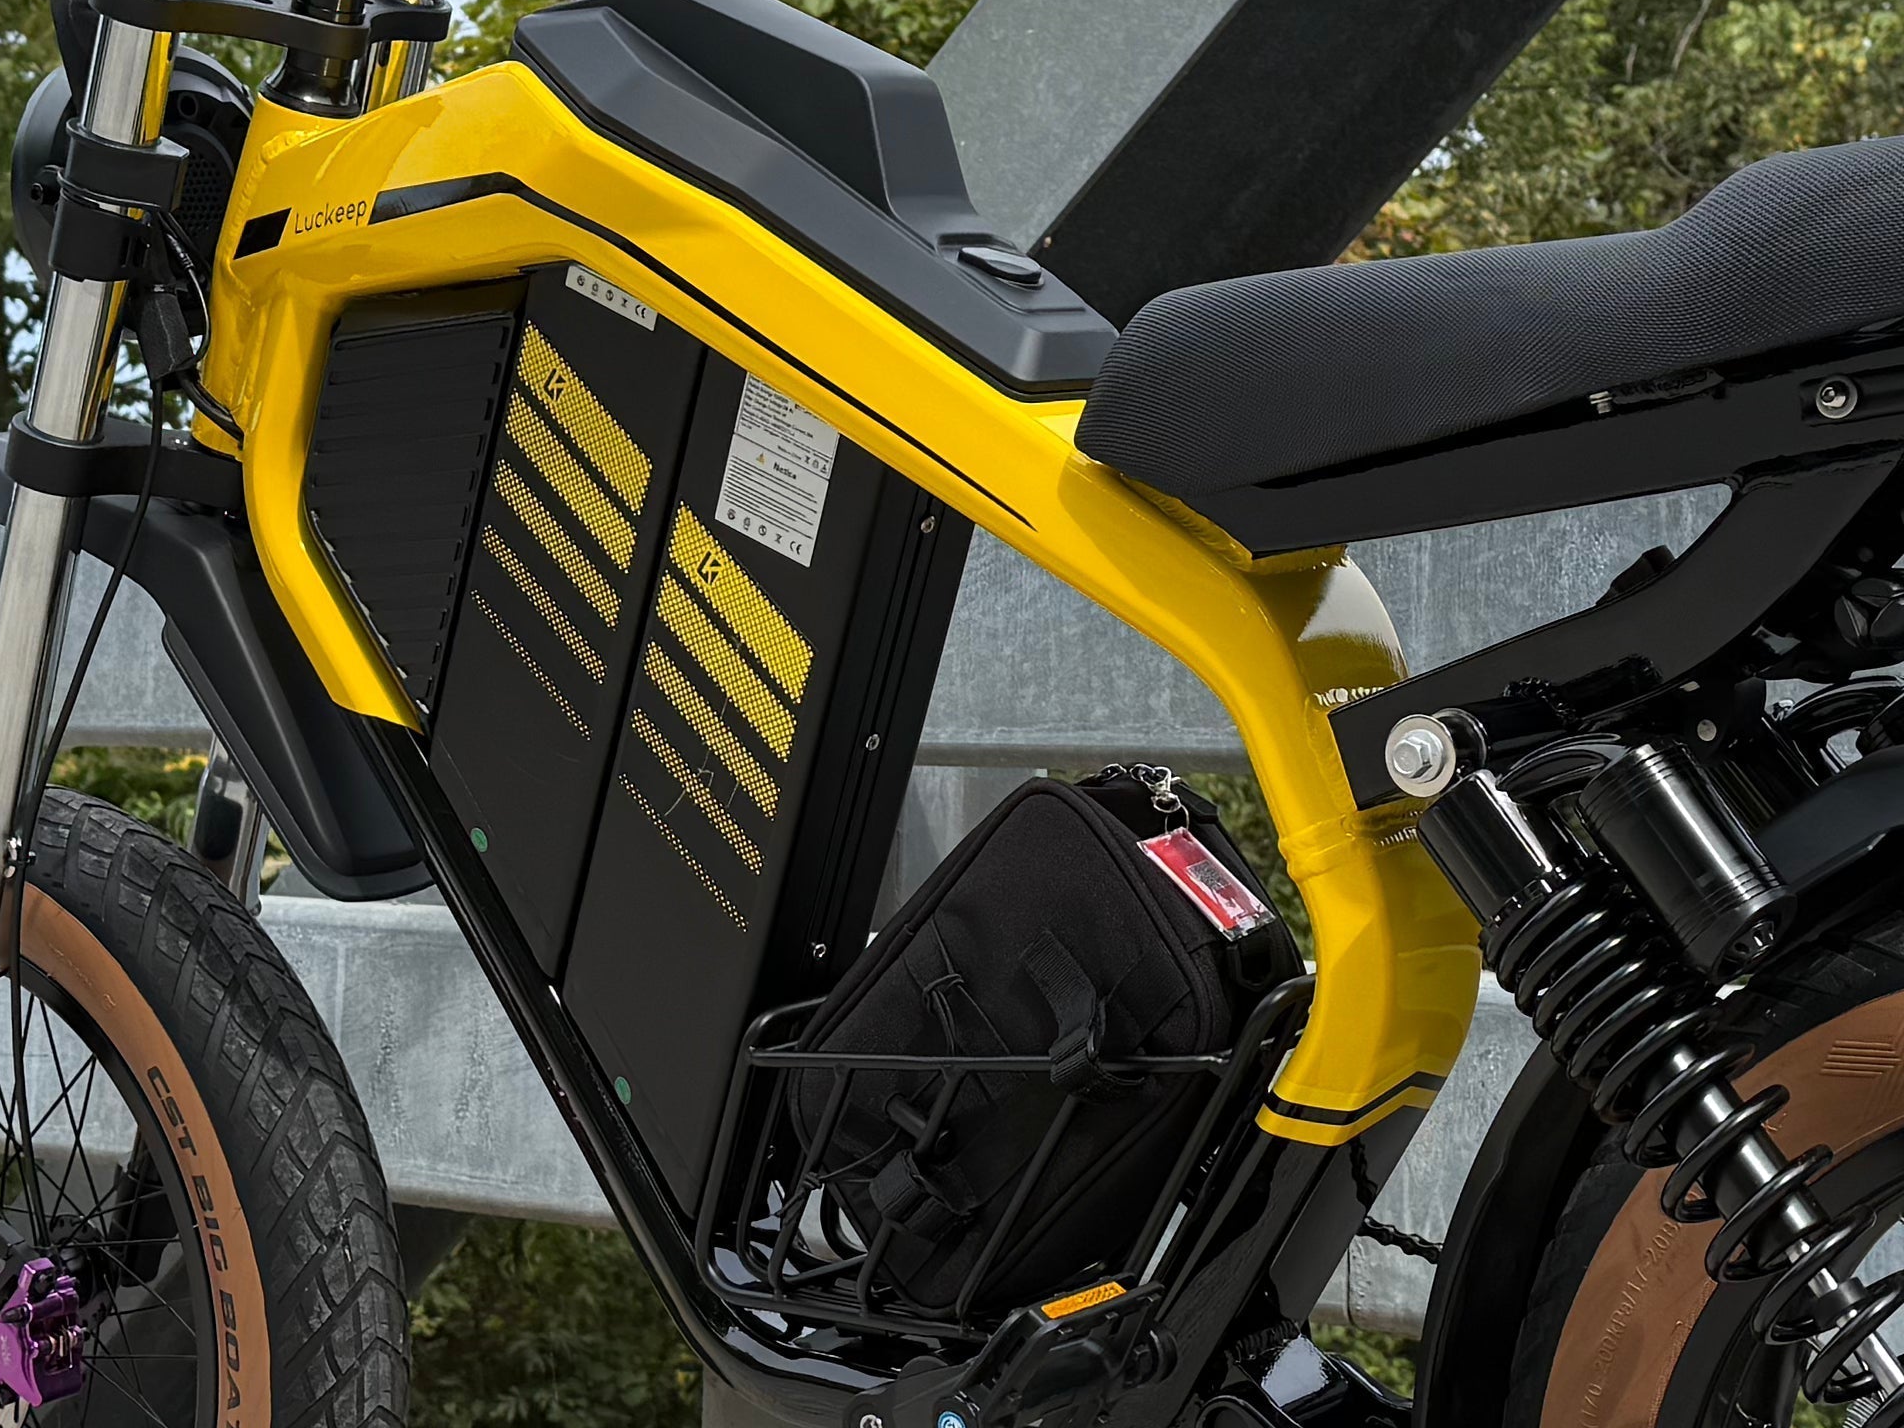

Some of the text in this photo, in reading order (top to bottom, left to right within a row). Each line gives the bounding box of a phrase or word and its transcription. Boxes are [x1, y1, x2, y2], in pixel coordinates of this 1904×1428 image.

[294, 200, 367, 235] Luckeep
[147, 1066, 197, 1156] CST
[192, 1174, 229, 1272] BIG
